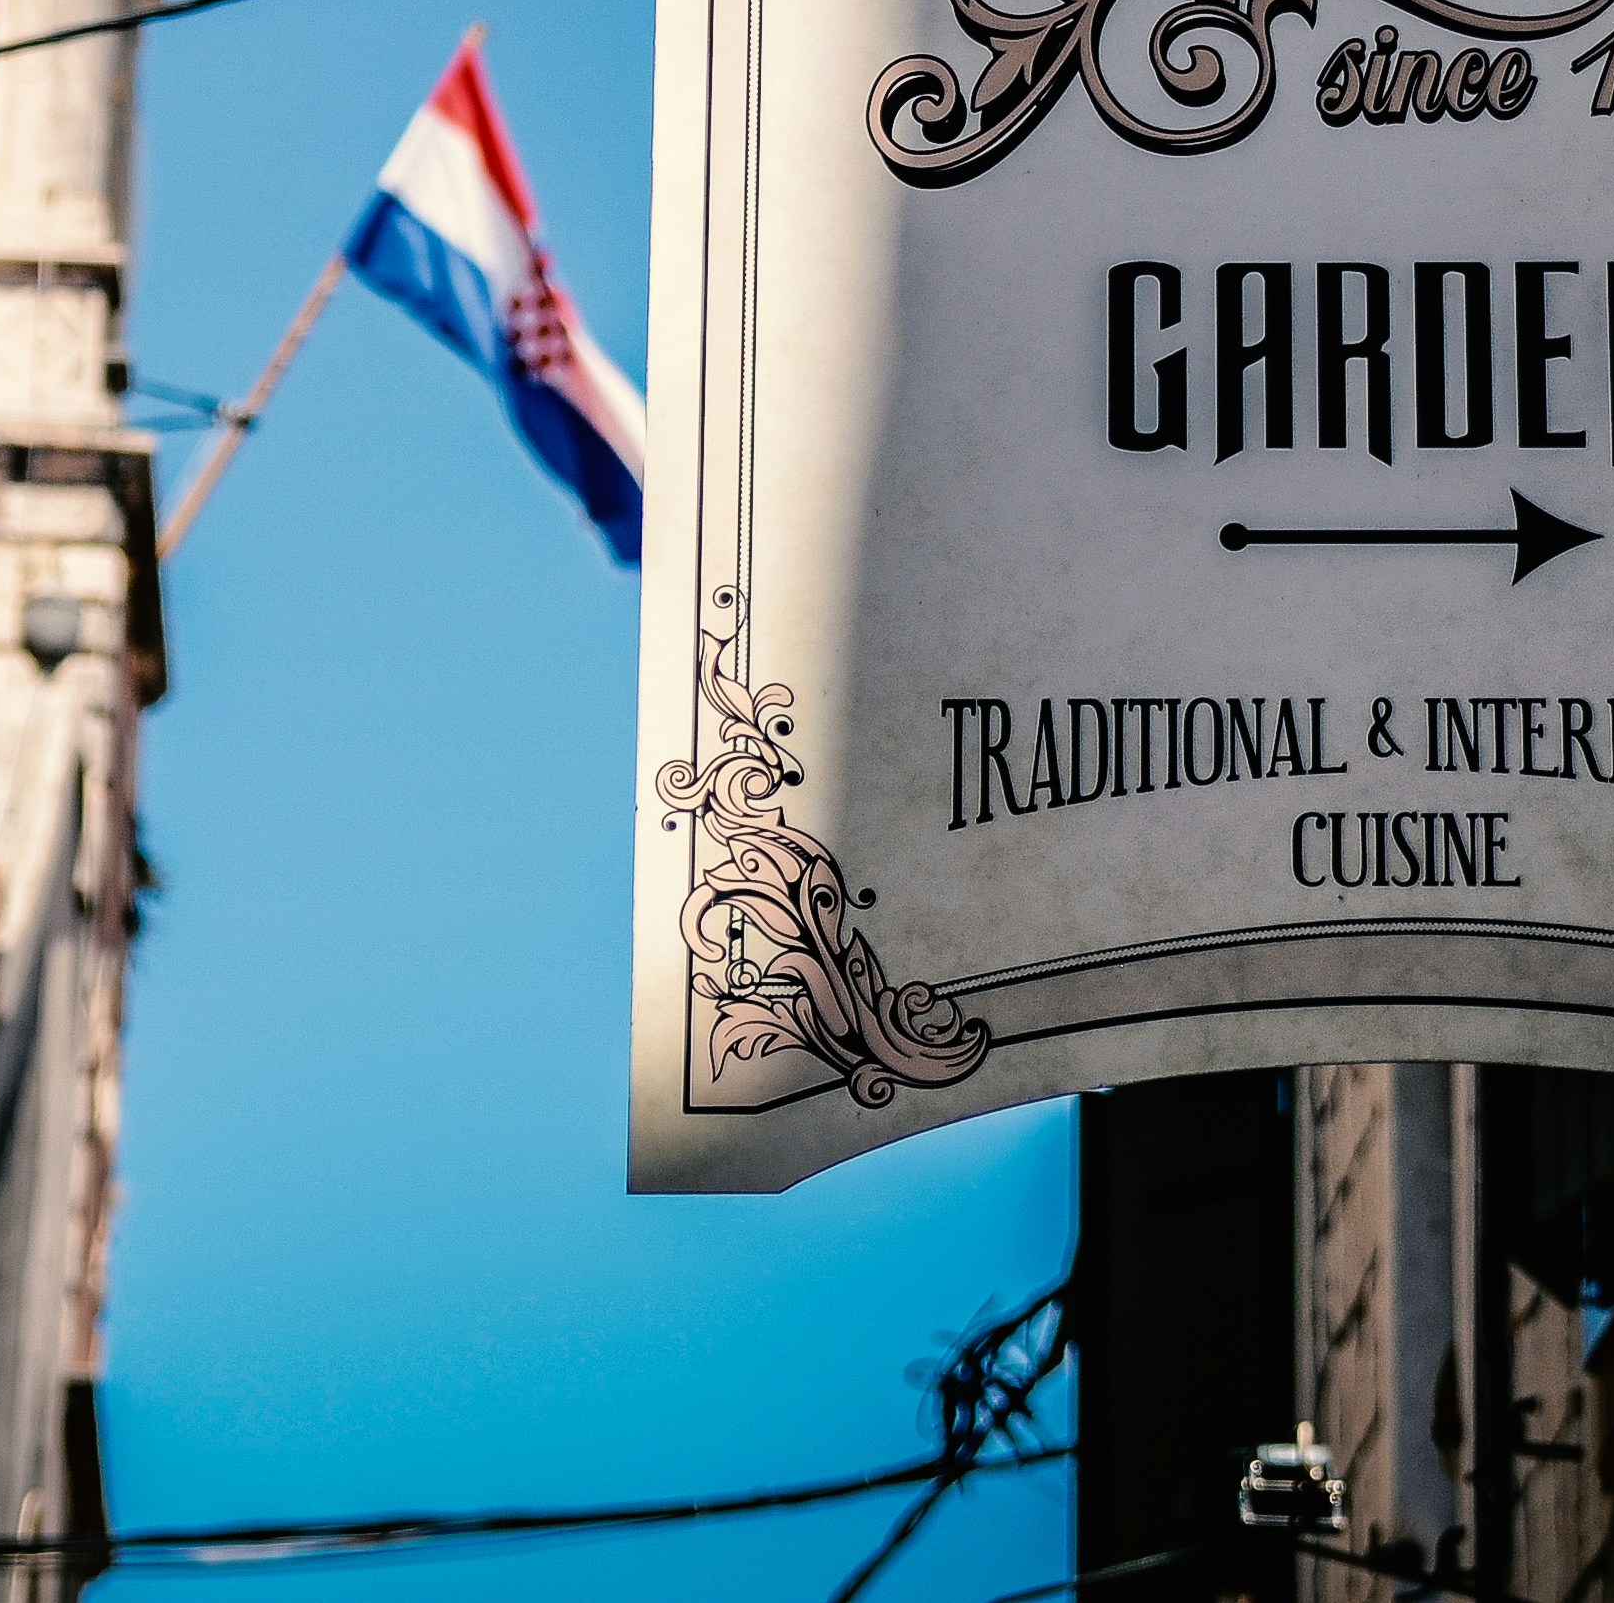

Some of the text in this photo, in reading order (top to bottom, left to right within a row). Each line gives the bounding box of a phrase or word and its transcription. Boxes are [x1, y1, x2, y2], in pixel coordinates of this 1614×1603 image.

[1316, 25, 1538, 128] since
[941, 697, 1348, 831] TRADITIONAL
[1367, 696, 1405, 758] &
[1291, 811, 1522, 888] CUISINE
